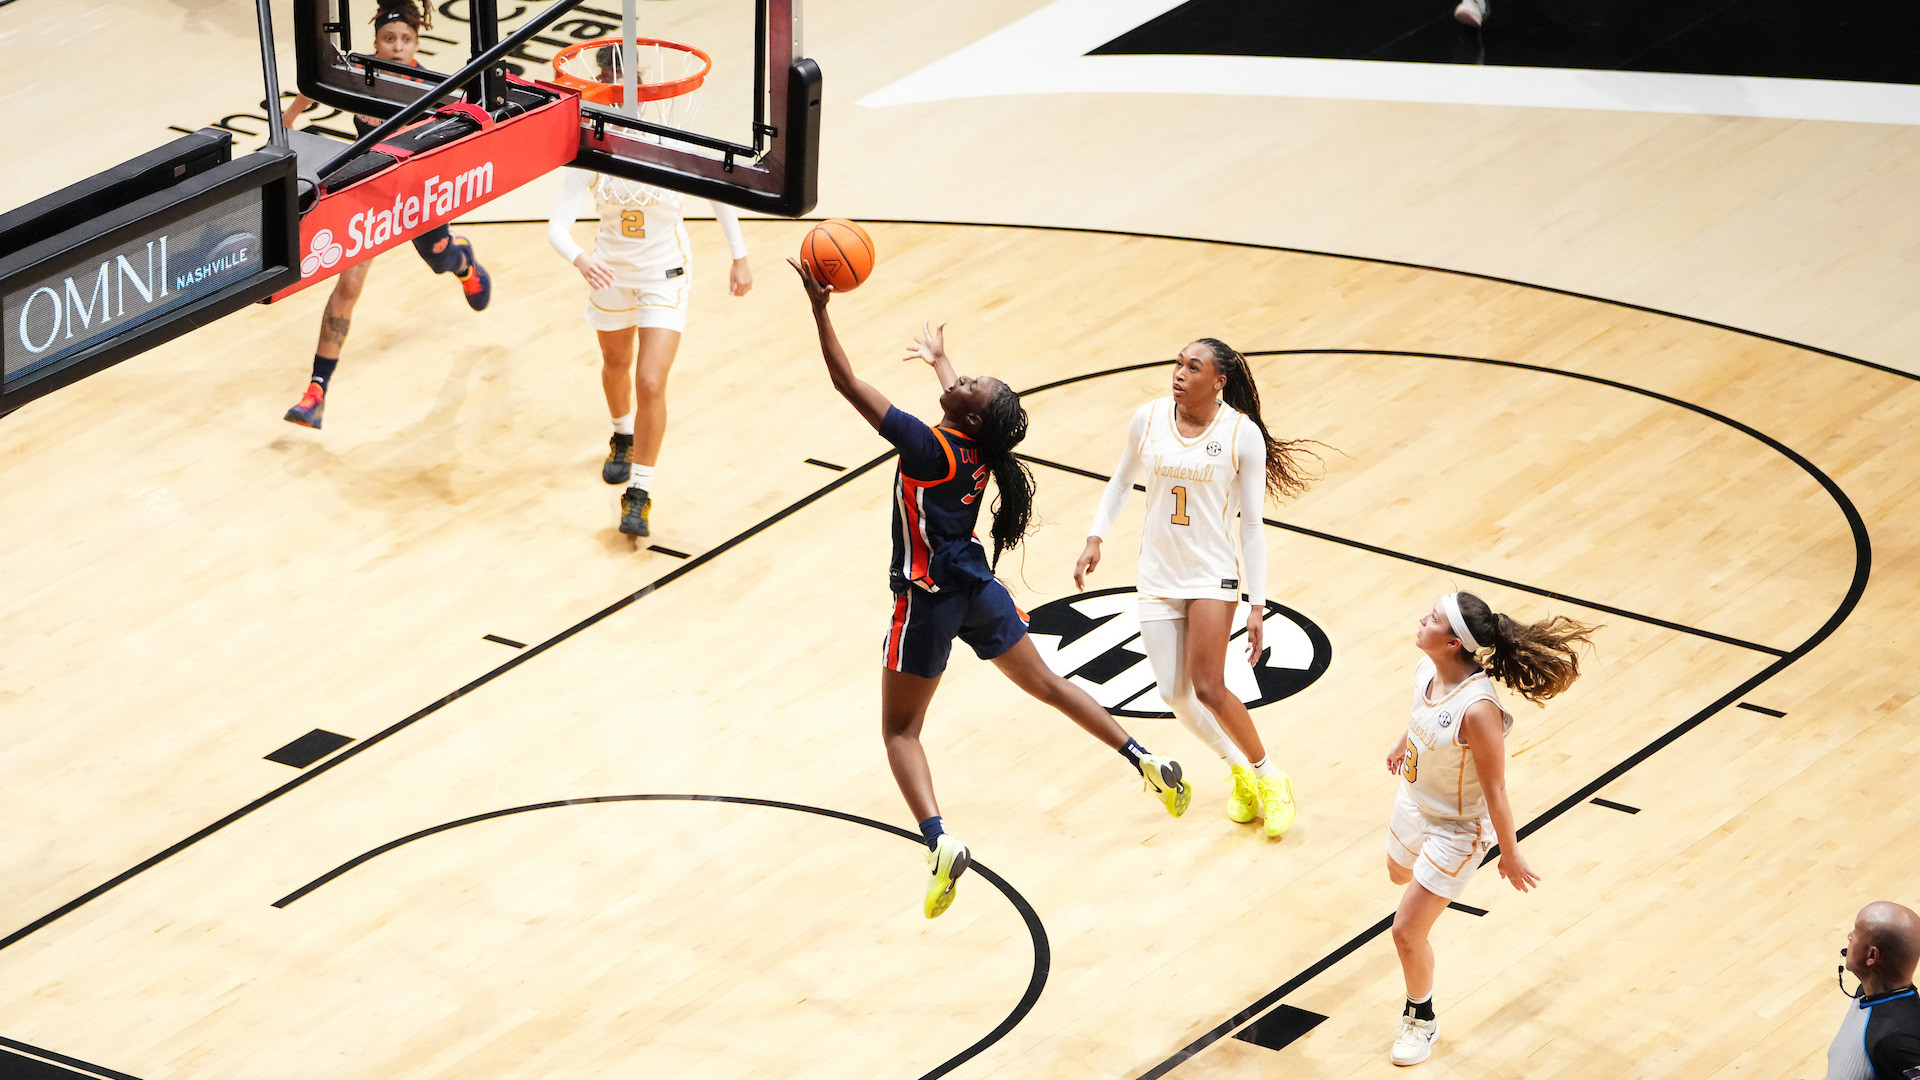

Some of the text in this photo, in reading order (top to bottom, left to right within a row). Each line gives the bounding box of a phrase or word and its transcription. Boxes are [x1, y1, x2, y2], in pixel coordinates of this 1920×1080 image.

[620, 209, 646, 239] 2
[19, 235, 249, 353] OMNI NASHVILLE
[960, 463, 990, 506] 3
[1153, 454, 1215, 483] Vanderbilt
[1170, 485, 1191, 527] 1
[1401, 737, 1419, 784] 3
